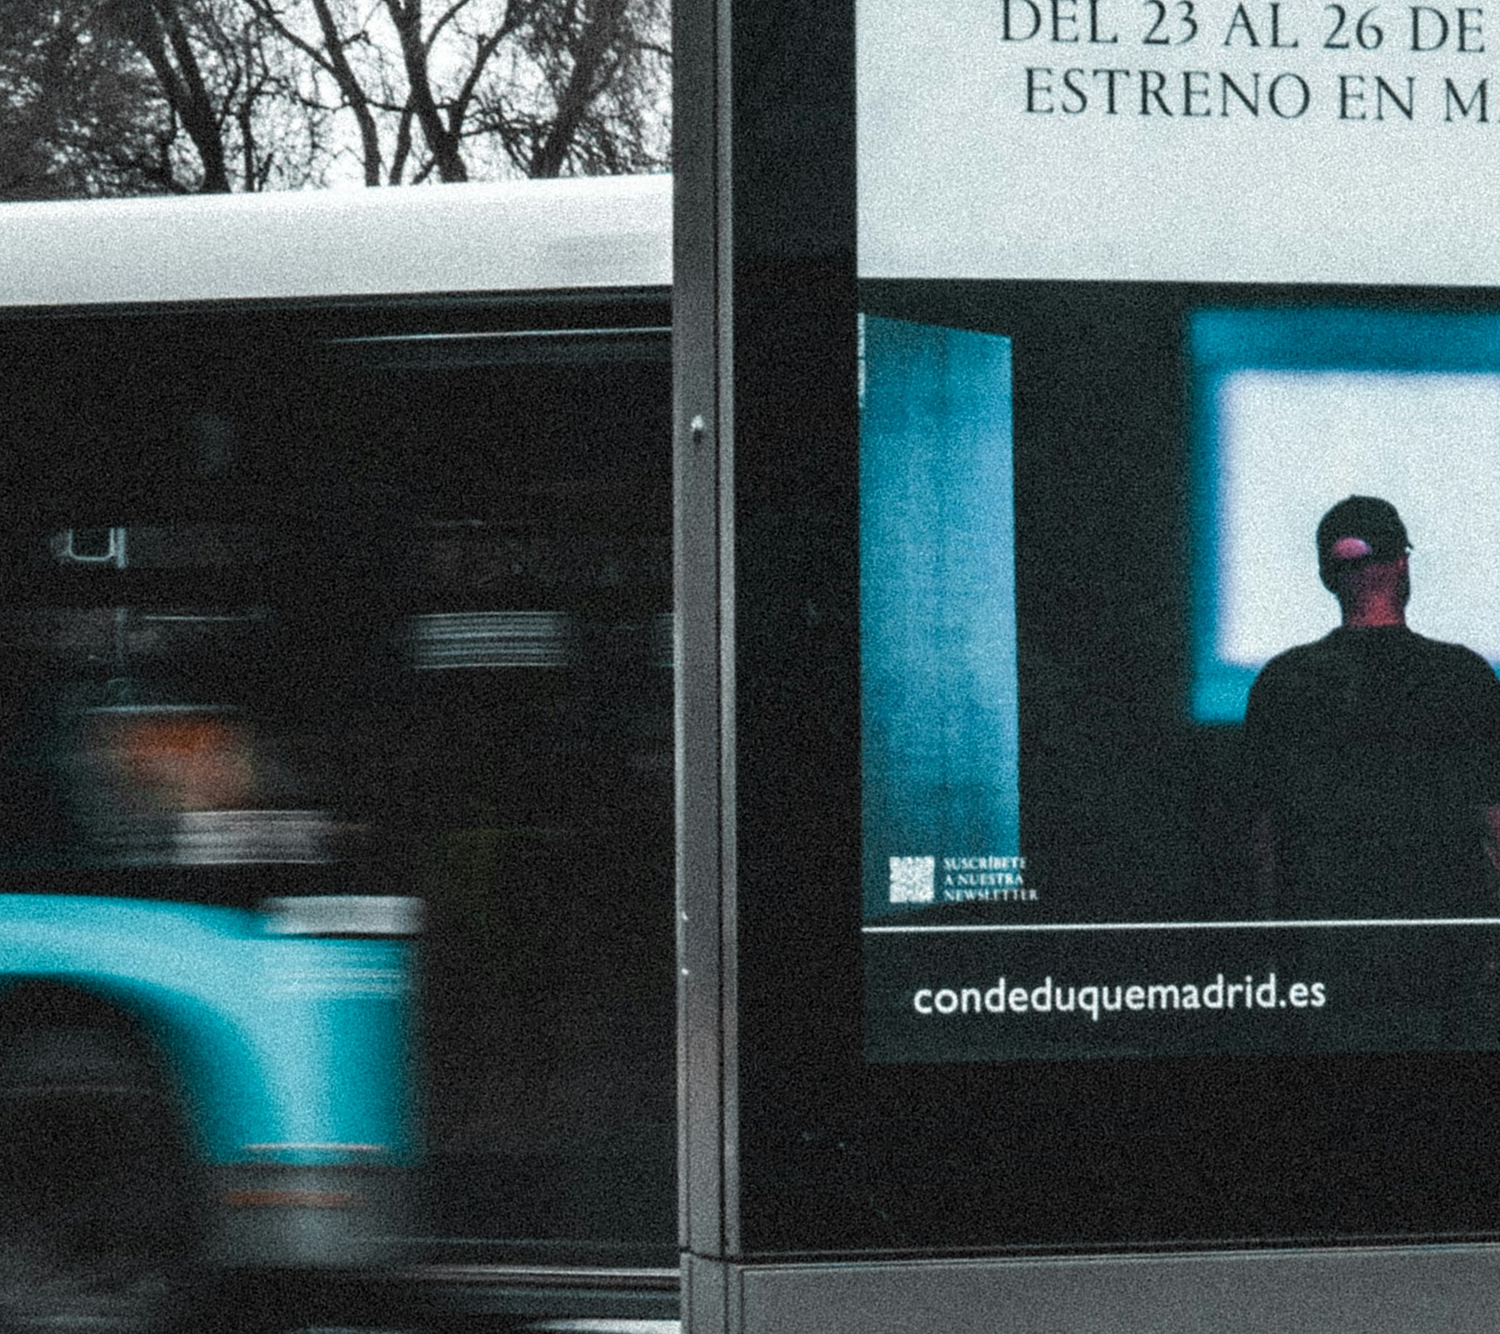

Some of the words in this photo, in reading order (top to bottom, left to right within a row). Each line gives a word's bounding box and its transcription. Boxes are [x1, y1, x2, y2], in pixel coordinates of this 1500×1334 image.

[1222, 2, 1300, 49] AL
[1322, 3, 1385, 51] 26
[1408, 5, 1486, 54] DE
[1024, 66, 1312, 120] ESTRENO
[1337, 73, 1417, 122] EN
[943, 888, 1039, 902] NEWSLETTER
[944, 873, 955, 886] A
[957, 872, 1025, 887] NUESTRA
[913, 972, 1327, 1022] condeduquemadrid.es
